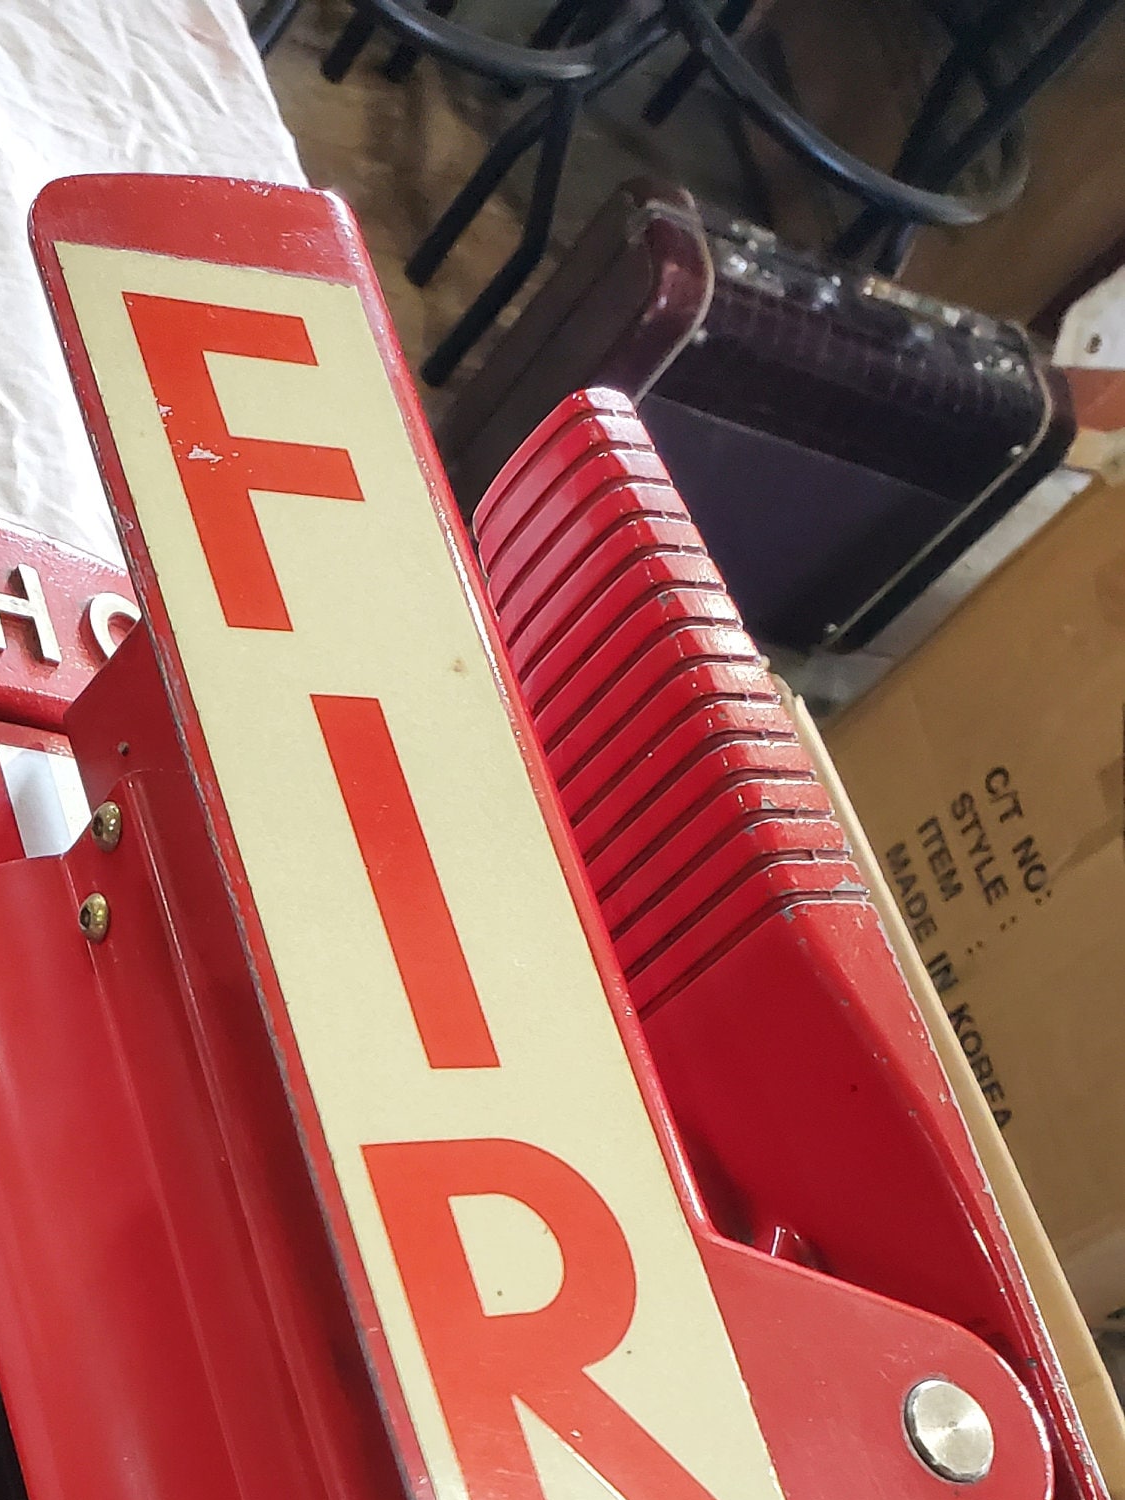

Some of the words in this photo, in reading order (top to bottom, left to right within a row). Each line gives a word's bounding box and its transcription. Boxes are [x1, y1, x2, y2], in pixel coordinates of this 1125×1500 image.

[985, 766, 1024, 824] C/T
[918, 816, 964, 902] ITEM
[951, 791, 1009, 906] STYLE
[886, 843, 938, 943] MADE
[925, 951, 959, 993] IN
[948, 1002, 1013, 1129] KOREA
